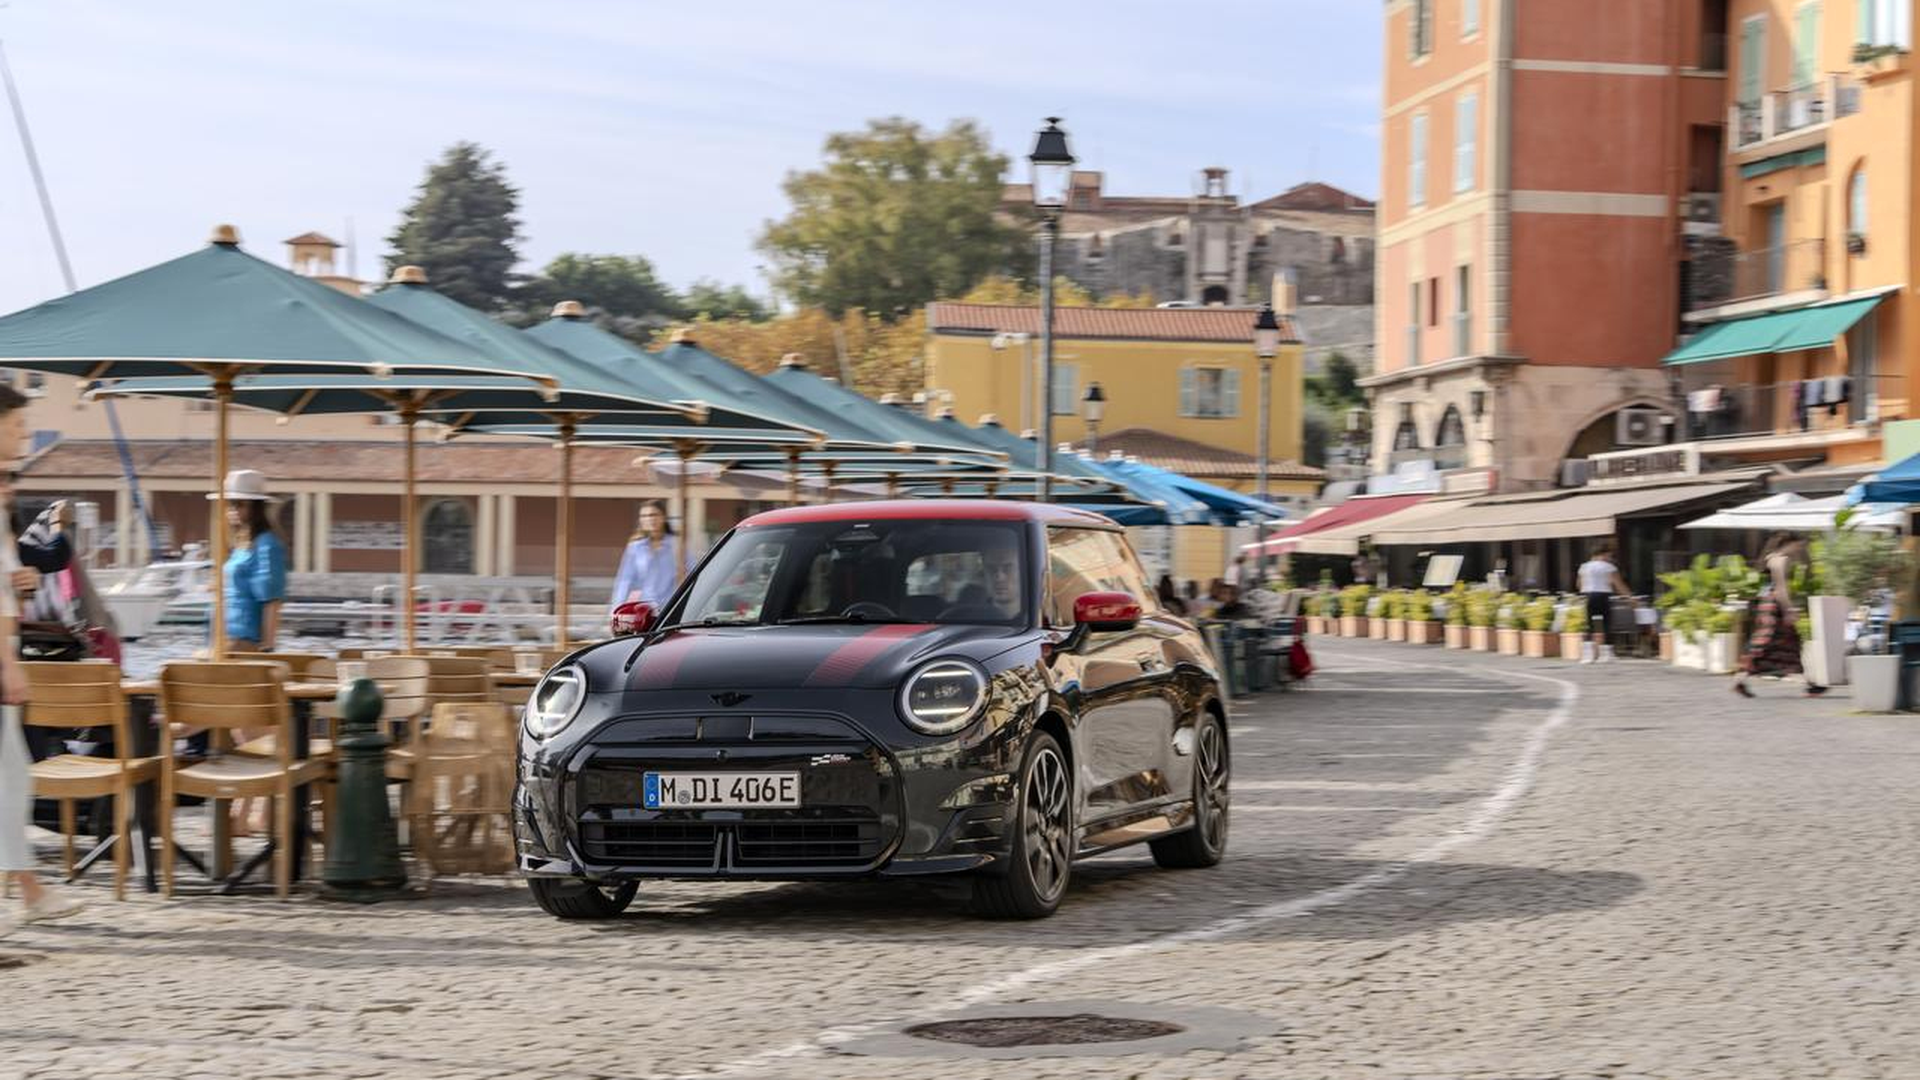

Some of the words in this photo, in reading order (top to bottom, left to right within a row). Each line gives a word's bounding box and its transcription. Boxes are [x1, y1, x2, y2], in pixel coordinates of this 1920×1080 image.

[660, 777, 676, 803] M
[692, 777, 722, 803] DI
[730, 777, 795, 803] 406E
